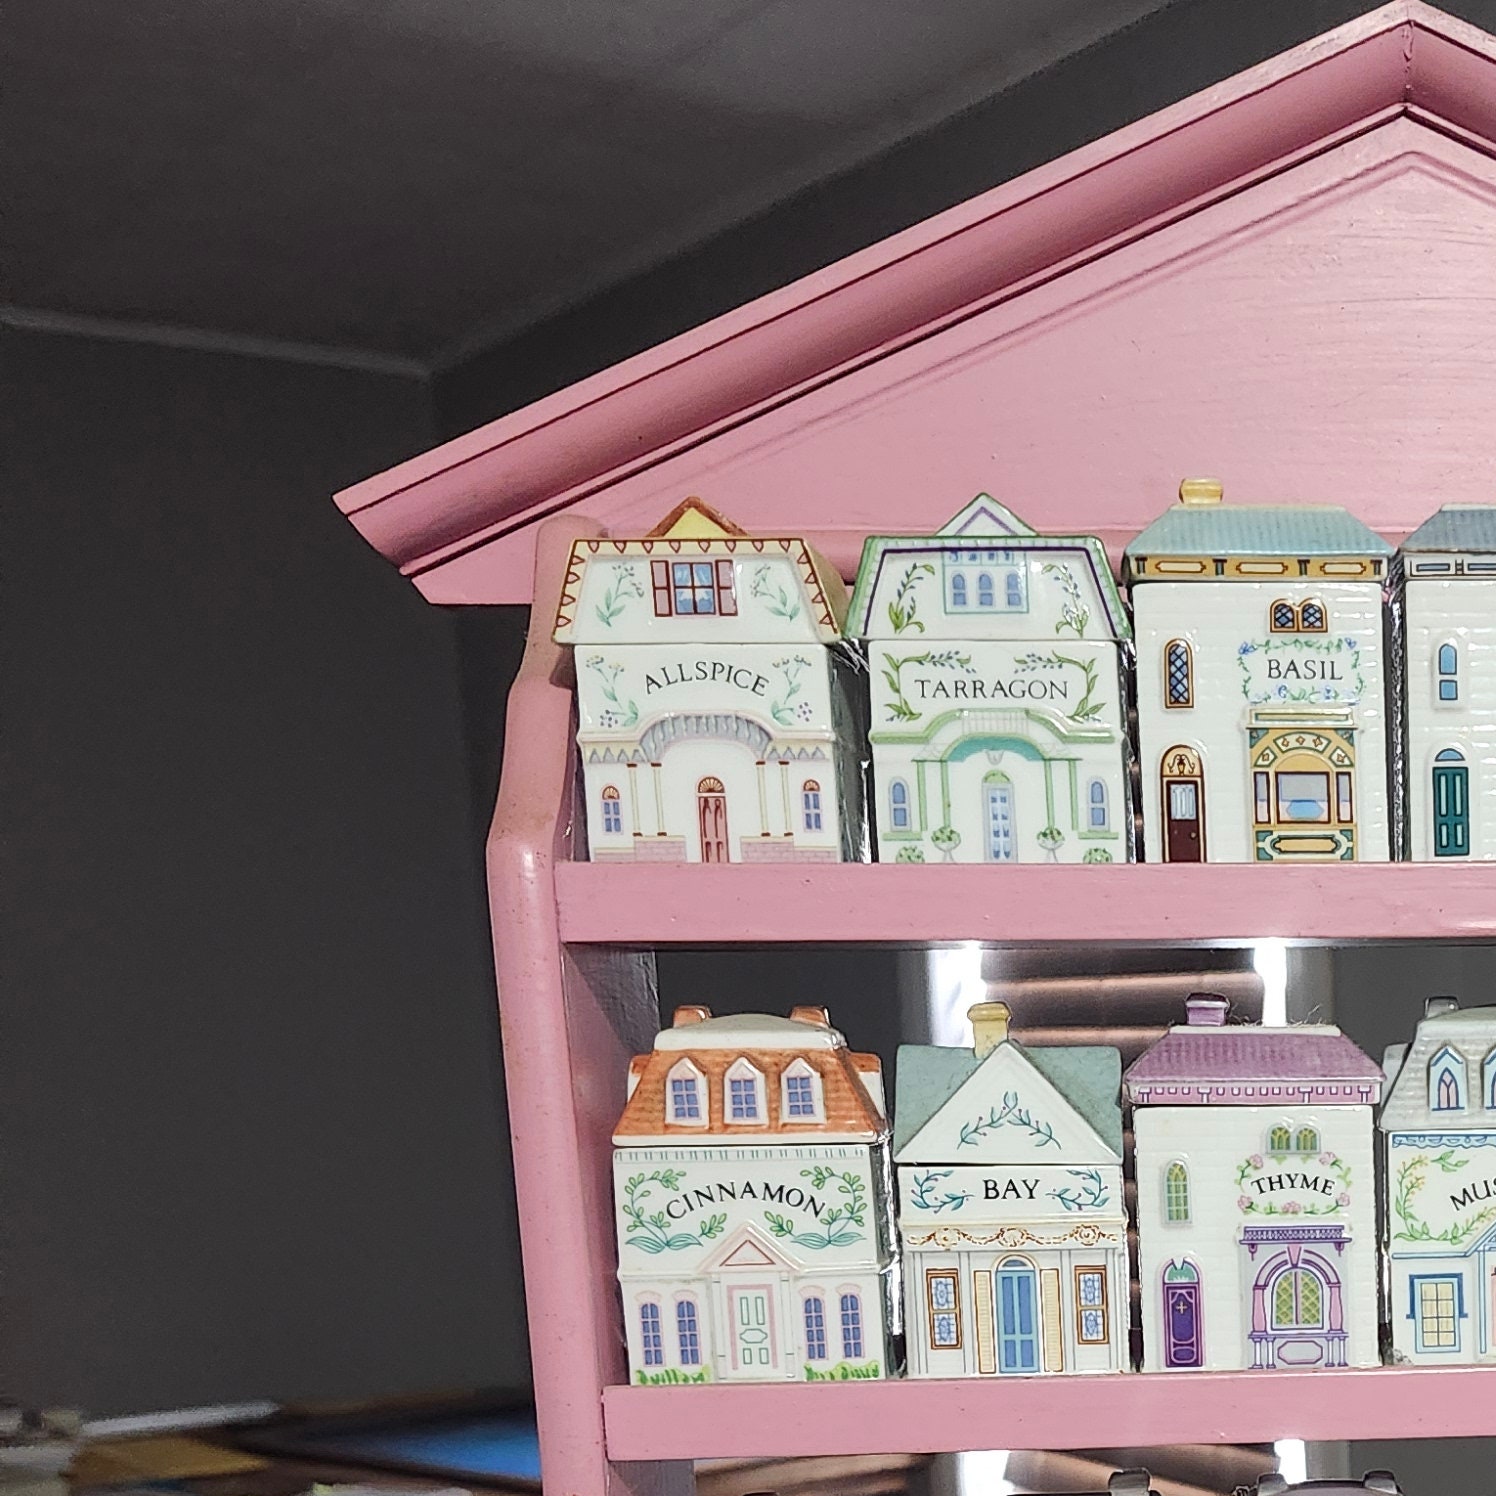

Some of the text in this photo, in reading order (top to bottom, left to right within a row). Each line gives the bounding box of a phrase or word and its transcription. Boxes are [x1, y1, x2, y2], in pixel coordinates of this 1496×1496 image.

[643, 660, 770, 697] ALLSPICE
[1267, 658, 1344, 681] BASIL
[913, 678, 1069, 700] TARRAGON
[983, 1178, 1041, 1201] BAY
[1250, 1173, 1336, 1197] THYME
[665, 1180, 827, 1219] CINNAMON
